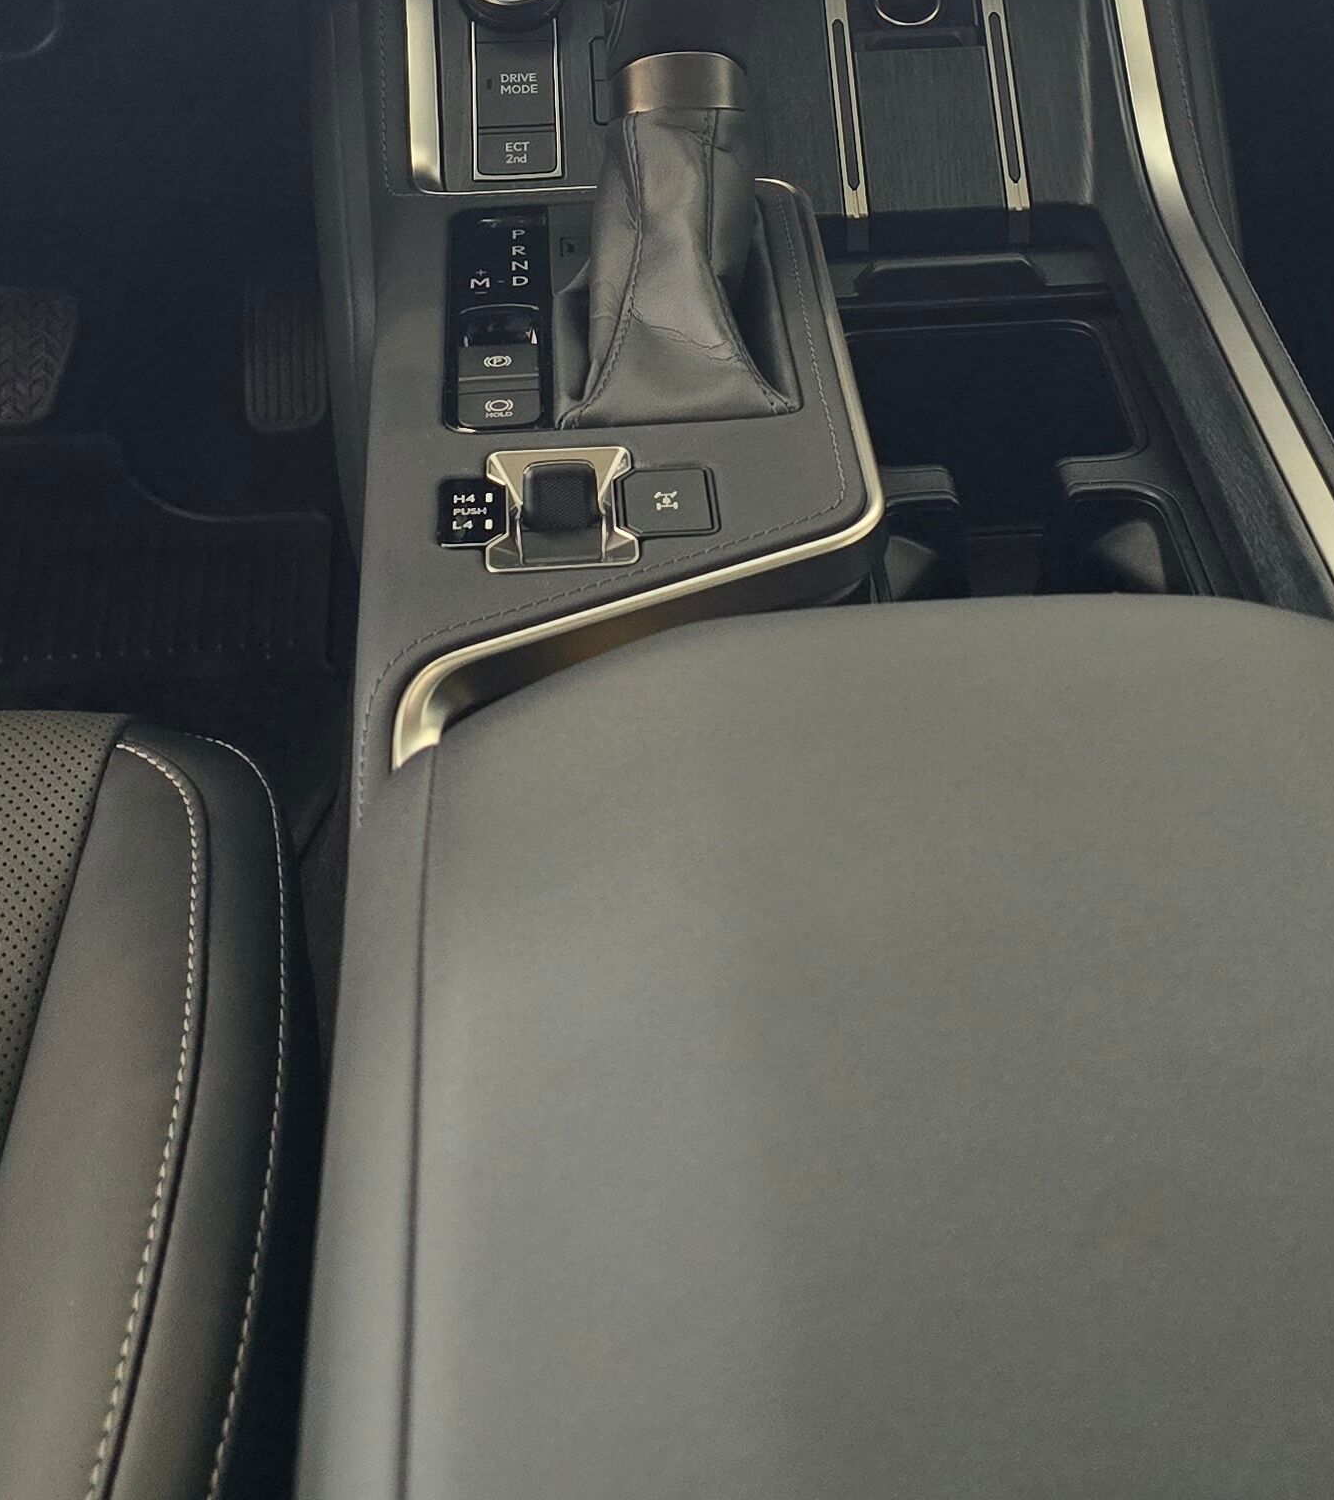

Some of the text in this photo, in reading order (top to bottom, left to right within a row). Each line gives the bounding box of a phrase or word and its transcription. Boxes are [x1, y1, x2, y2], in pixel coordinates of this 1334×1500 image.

[500, 73, 537, 83] DRIVE
[500, 84, 539, 95] MODE
[505, 141, 530, 152] ECT
[505, 153, 527, 164] 2nd
[512, 229, 525, 239] P
[511, 245, 526, 256] R
[511, 260, 529, 271] N
[470, 277, 490, 289] M
[512, 276, 529, 287] D
[453, 493, 476, 504] H4
[453, 506, 487, 516] PUSH
[452, 519, 474, 530] L4
